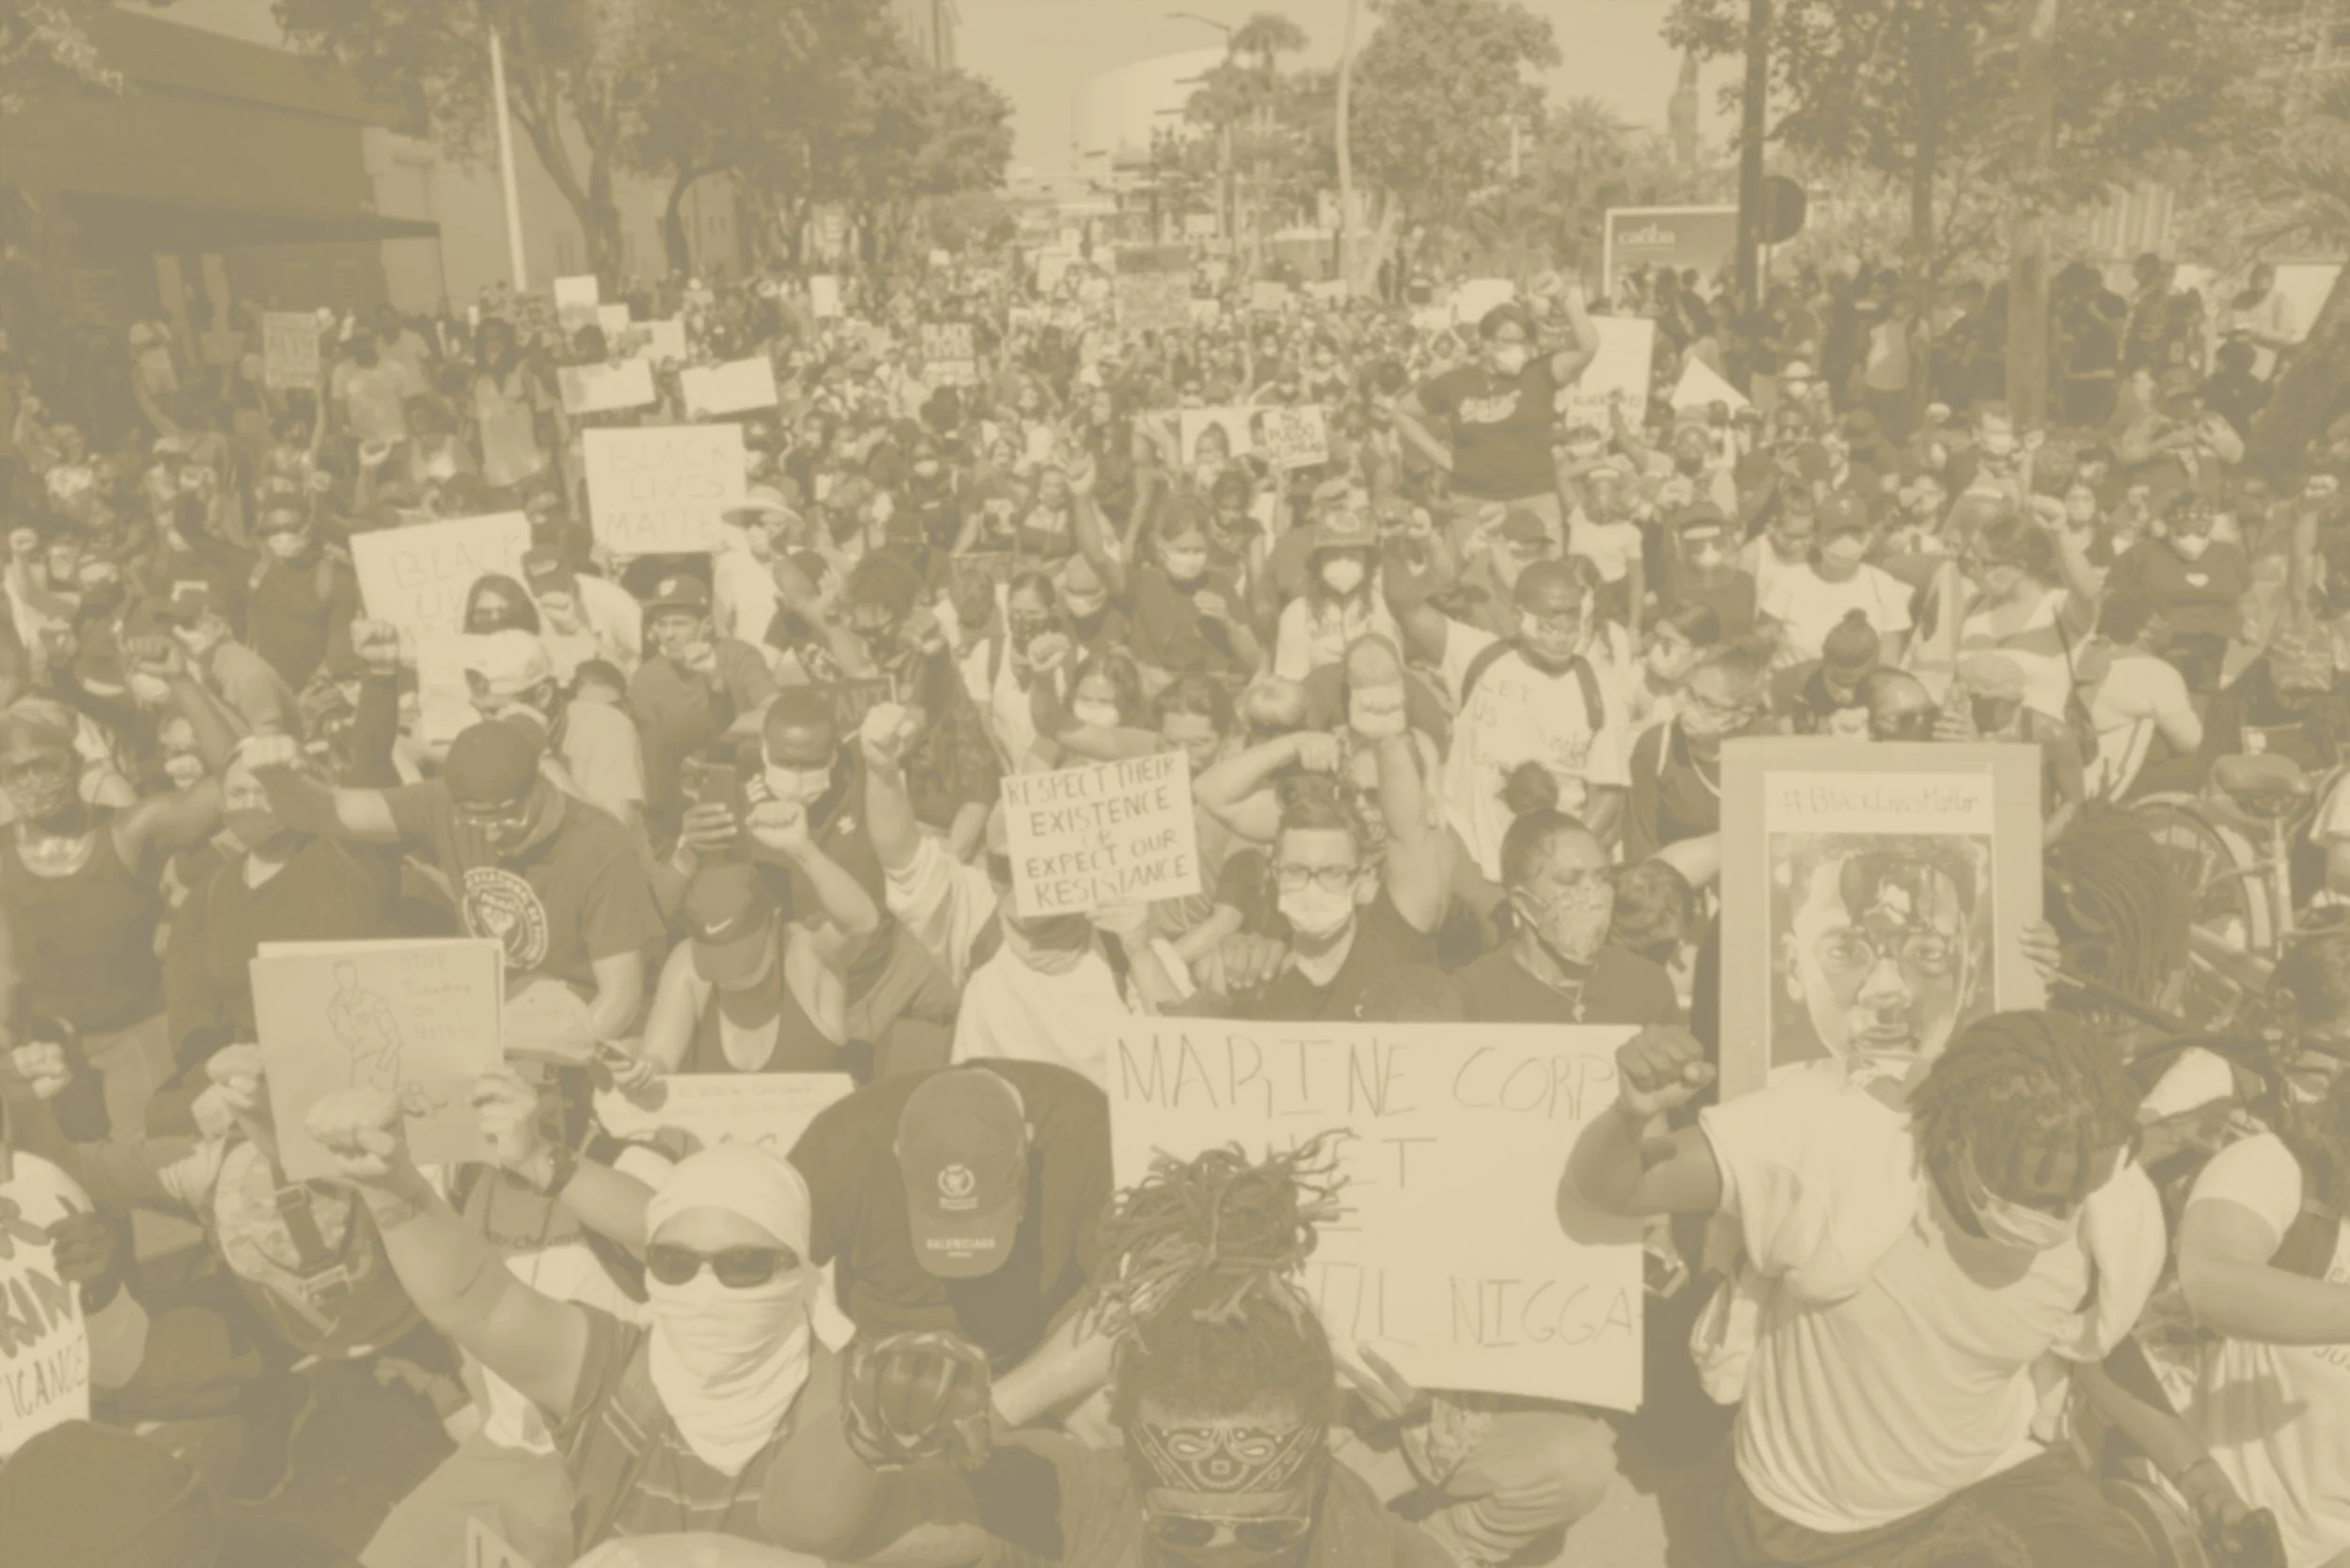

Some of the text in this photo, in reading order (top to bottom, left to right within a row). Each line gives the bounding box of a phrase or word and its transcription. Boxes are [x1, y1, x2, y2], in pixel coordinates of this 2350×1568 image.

[606, 437, 728, 474] BLACK
[629, 472, 727, 500] LIVES
[605, 507, 714, 543] MATTE
[389, 533, 521, 588] BLACK
[415, 587, 466, 620] LIV
[1117, 756, 1177, 790] THEIR
[1030, 786, 1172, 838] EXISTENCE
[1026, 827, 1180, 879] EXPECT OUR
[1117, 1032, 1418, 1120] MARINE
[1450, 1276, 1634, 1349] NIGGA
